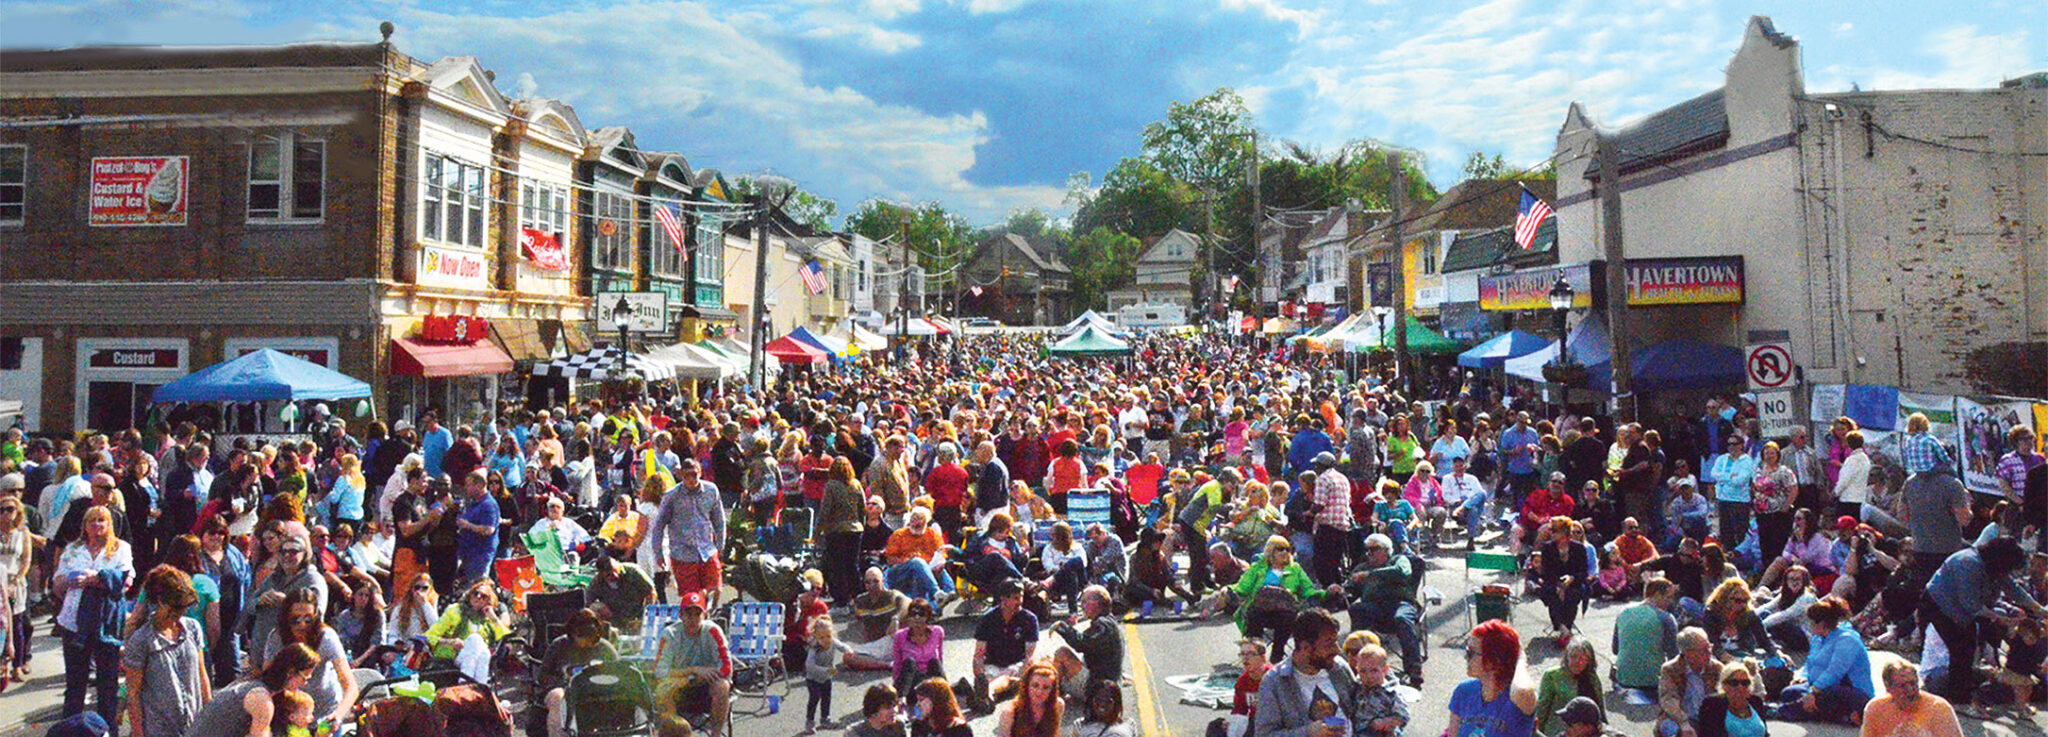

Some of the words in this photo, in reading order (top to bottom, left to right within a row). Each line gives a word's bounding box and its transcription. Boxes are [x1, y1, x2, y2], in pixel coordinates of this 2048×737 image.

[95, 182, 133, 194] Custard
[135, 182, 143, 194] &
[94, 196, 123, 207] Water
[439, 253, 459, 276] Now
[460, 256, 480, 278] Open
[1623, 265, 1738, 300] HAVERTOWN
[113, 350, 156, 364] Custard
[1764, 399, 1786, 414] NO
[1761, 418, 1793, 430] U-TURN
